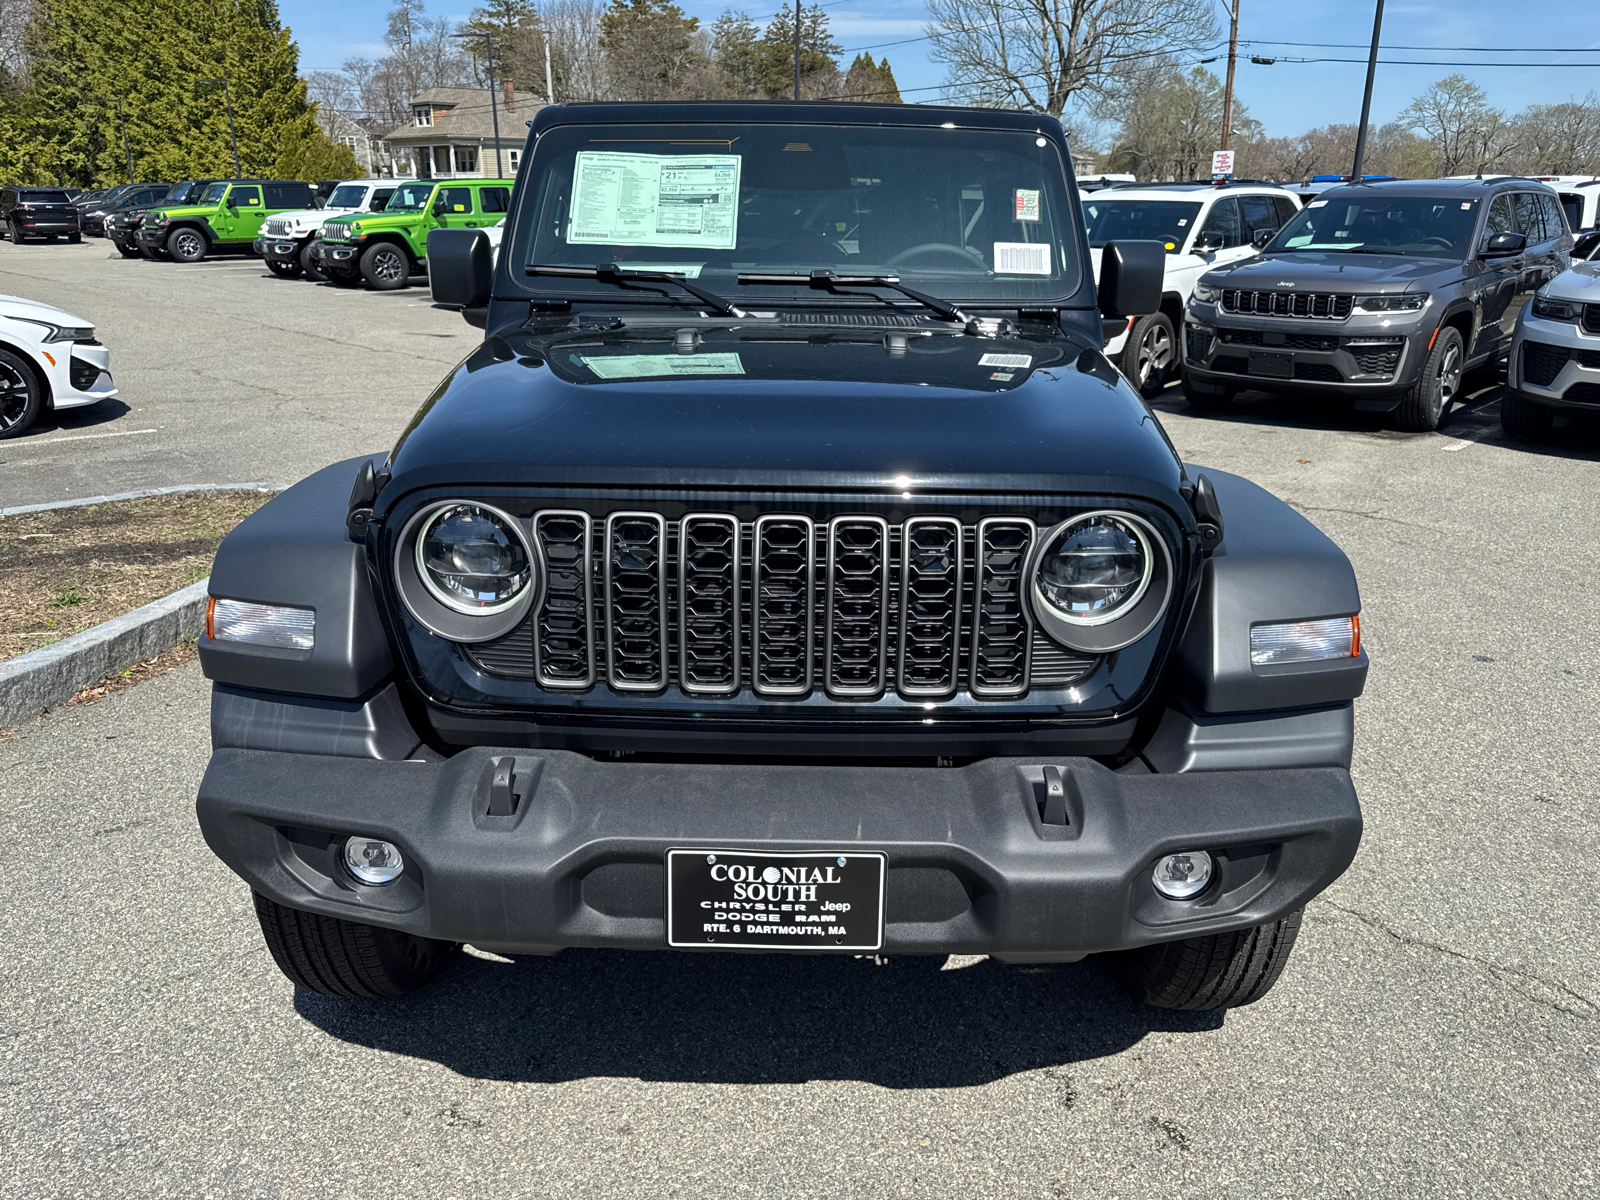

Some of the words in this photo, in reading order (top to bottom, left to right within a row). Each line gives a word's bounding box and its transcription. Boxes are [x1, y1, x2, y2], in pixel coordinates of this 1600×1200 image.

[1277, 280, 1295, 288] Jeep
[710, 864, 841, 884] COLONIAL
[733, 883, 817, 901] SOUTH
[700, 901, 807, 911] CHRYSLER
[820, 901, 851, 913] Jeep
[714, 912, 781, 922] DODGE
[795, 914, 836, 922] RAM
[703, 923, 730, 933] RTE.
[733, 924, 741, 933] 6
[746, 924, 825, 936] DARTMOUTH,
[828, 926, 847, 935] MA
